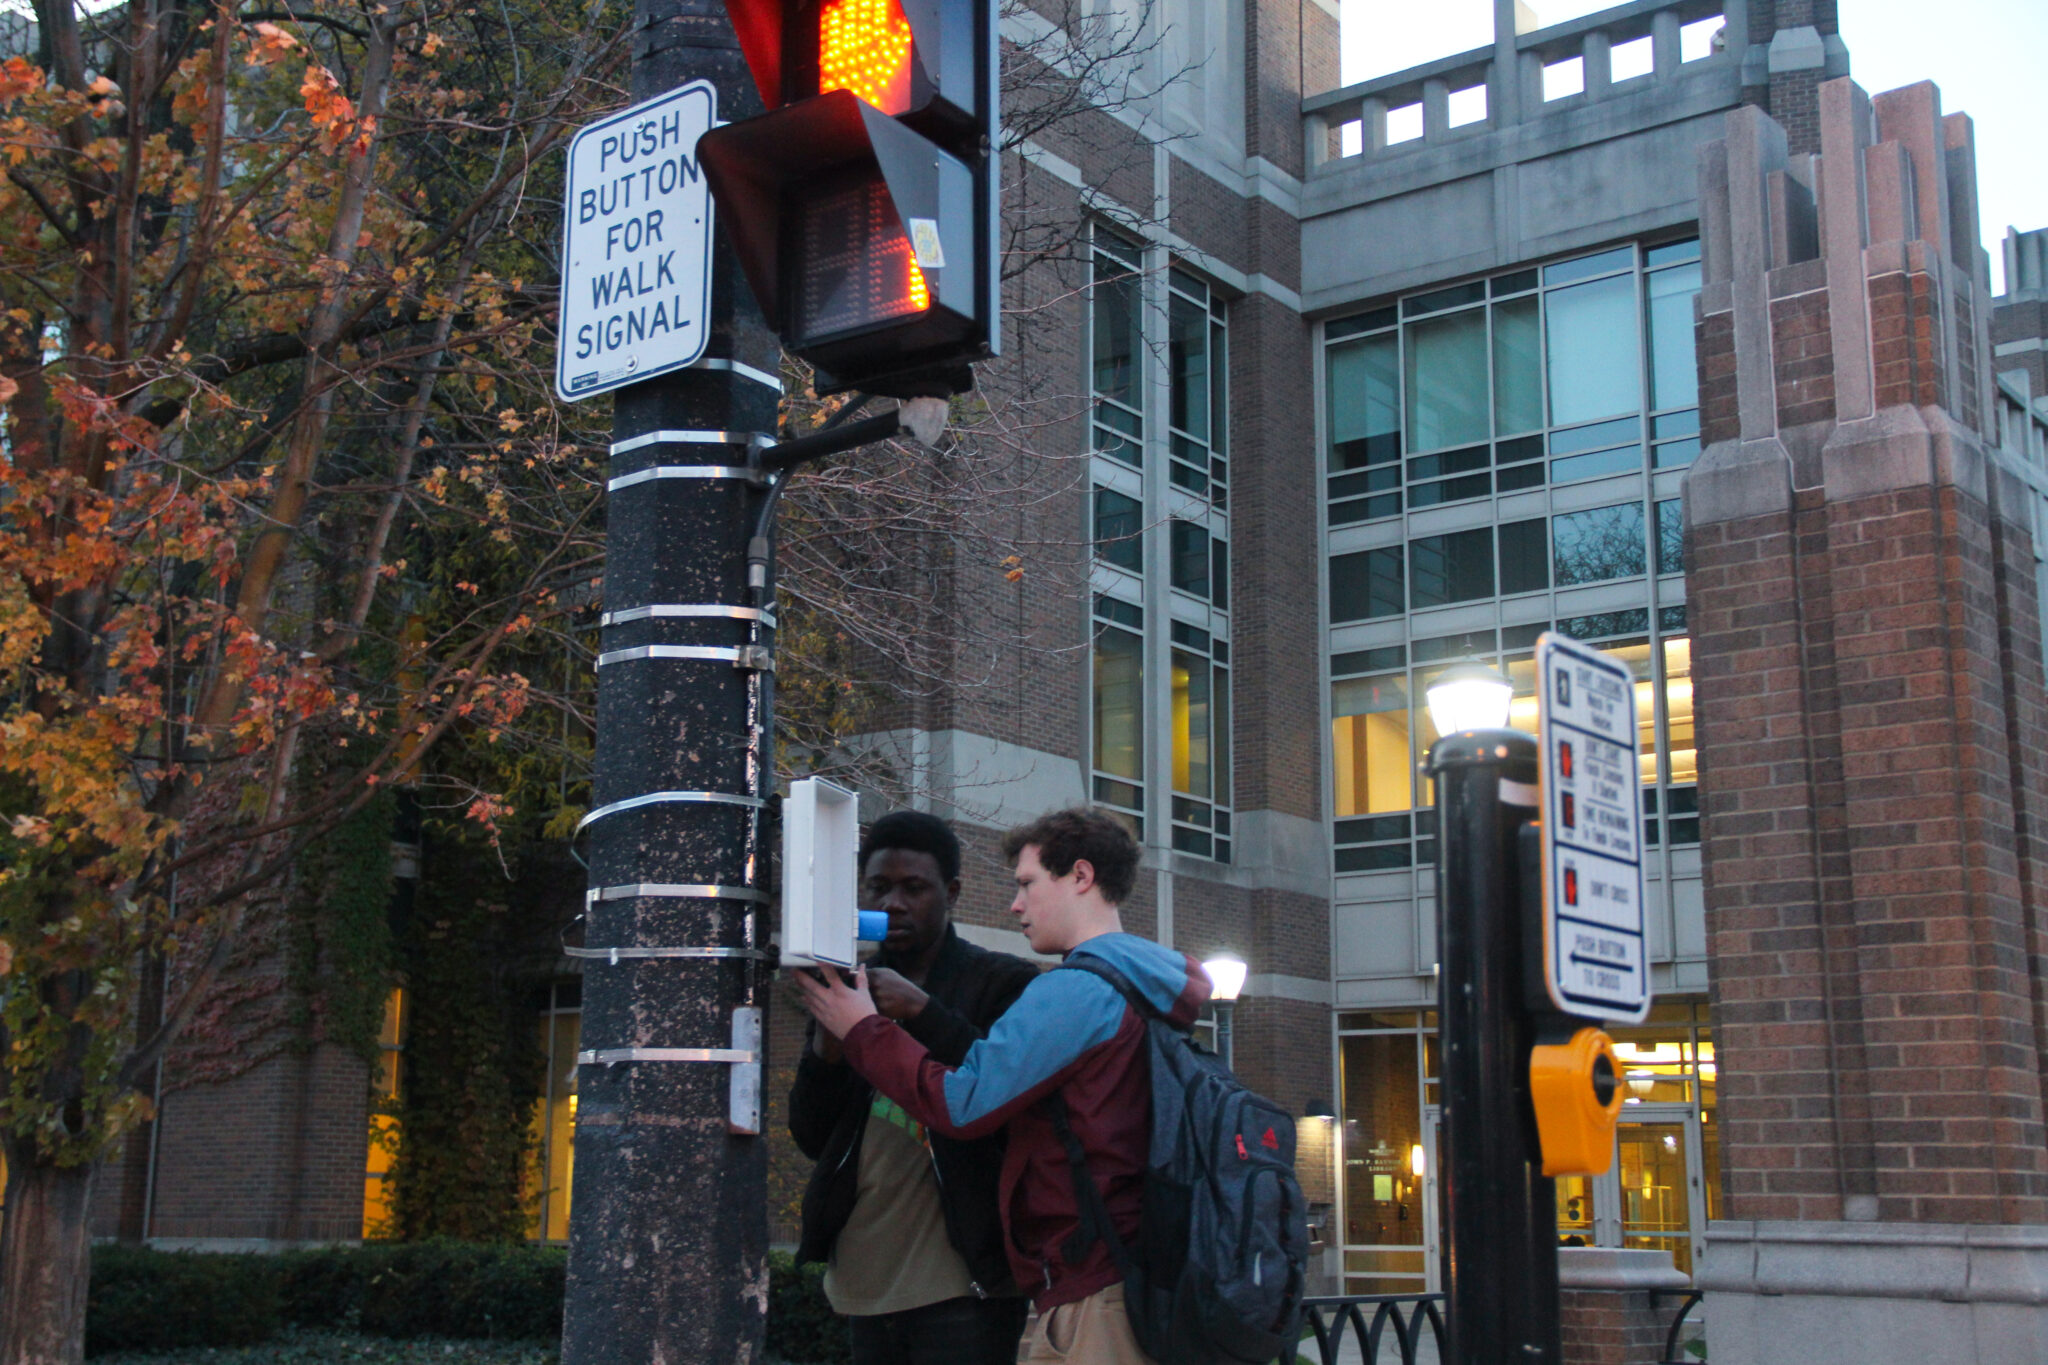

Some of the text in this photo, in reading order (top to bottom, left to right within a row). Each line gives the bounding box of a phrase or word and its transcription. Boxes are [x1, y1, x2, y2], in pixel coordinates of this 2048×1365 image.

[601, 110, 680, 172] PUSH
[580, 154, 699, 224] BUTTON
[606, 209, 664, 261] FOR
[592, 250, 676, 310] WALK
[576, 295, 691, 360] SIGNAL
